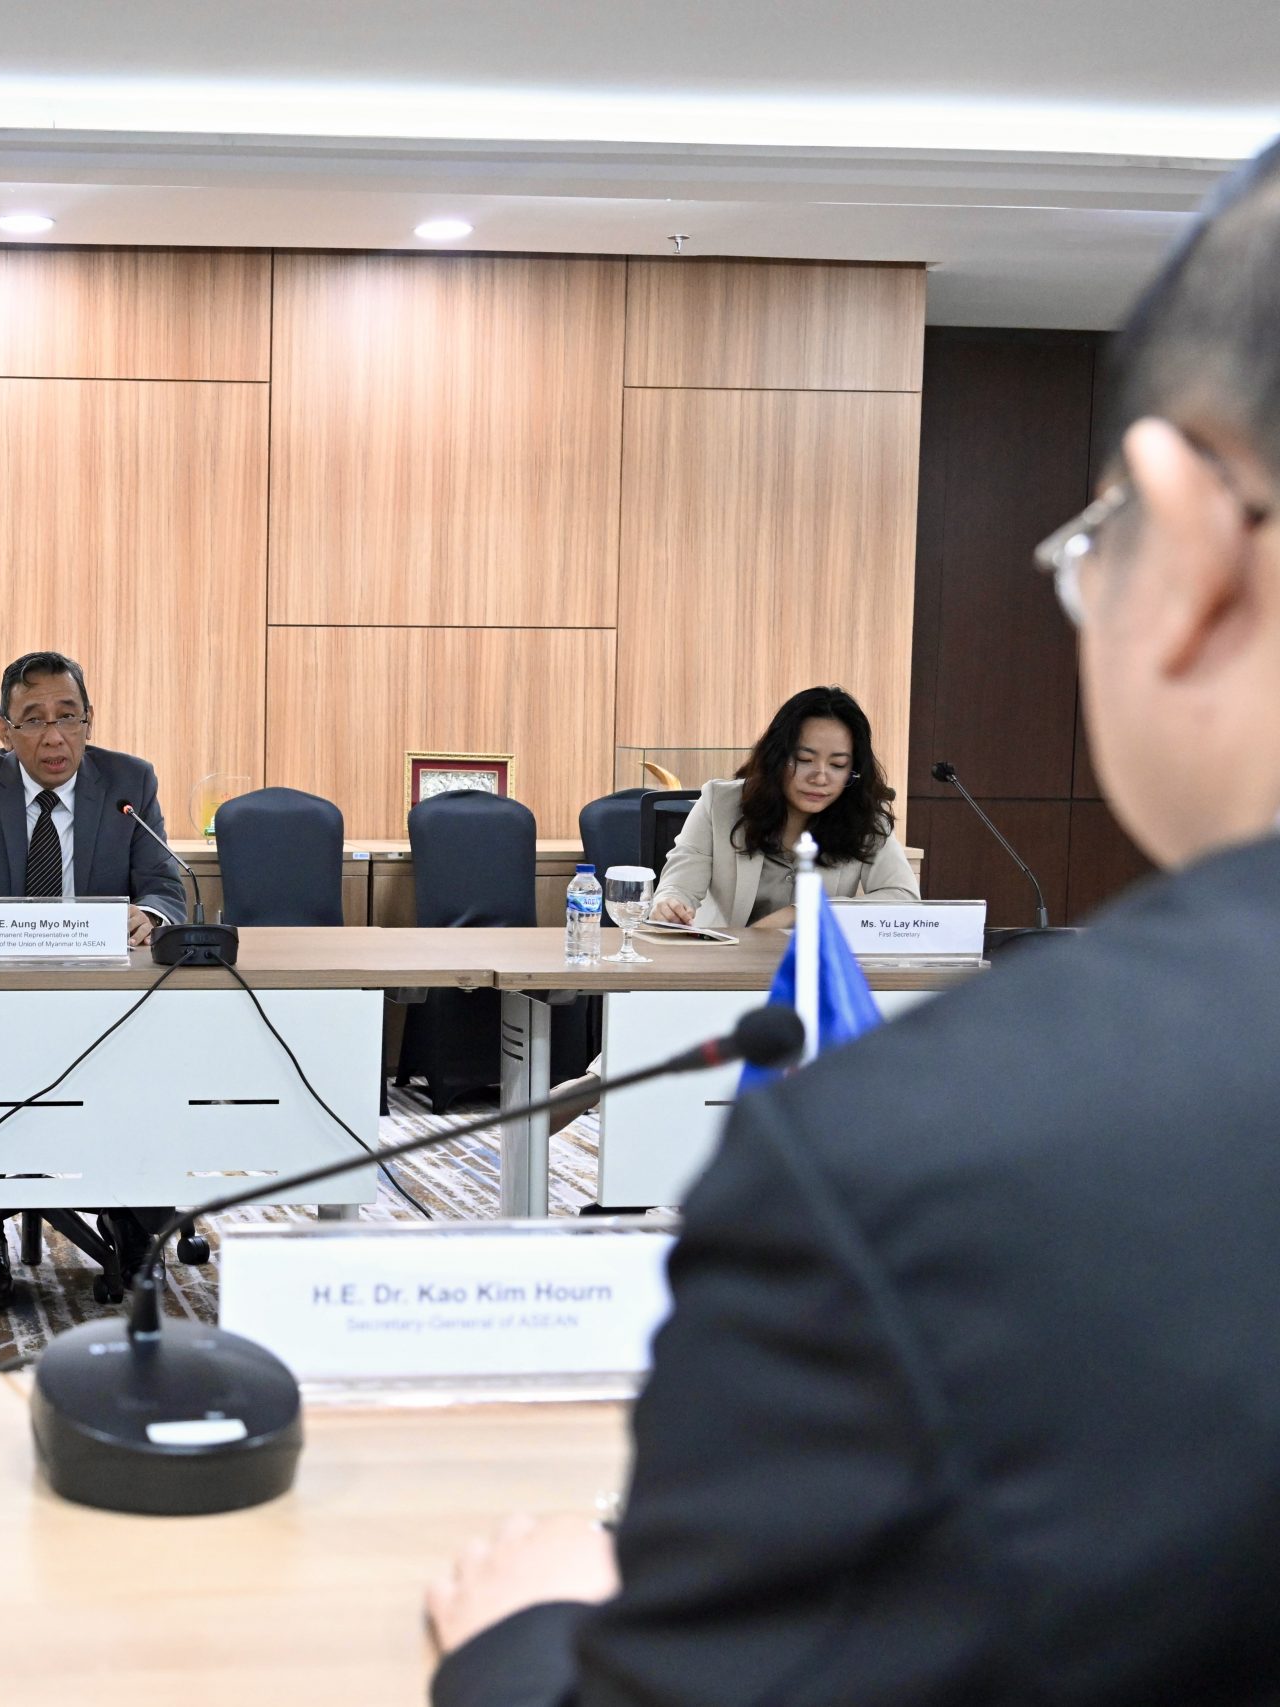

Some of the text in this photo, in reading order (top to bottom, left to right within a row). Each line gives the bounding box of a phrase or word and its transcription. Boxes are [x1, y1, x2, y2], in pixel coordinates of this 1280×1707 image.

[11, 920, 37, 930] Aung
[40, 920, 60, 930] Myo
[63, 920, 89, 930] Myint
[861, 920, 940, 930] Ms. Yu Lay Khine
[312, 1282, 612, 1305] H.E. Dr. Kao Kim Hourn
[520, 1314, 580, 1328] ASEAN
